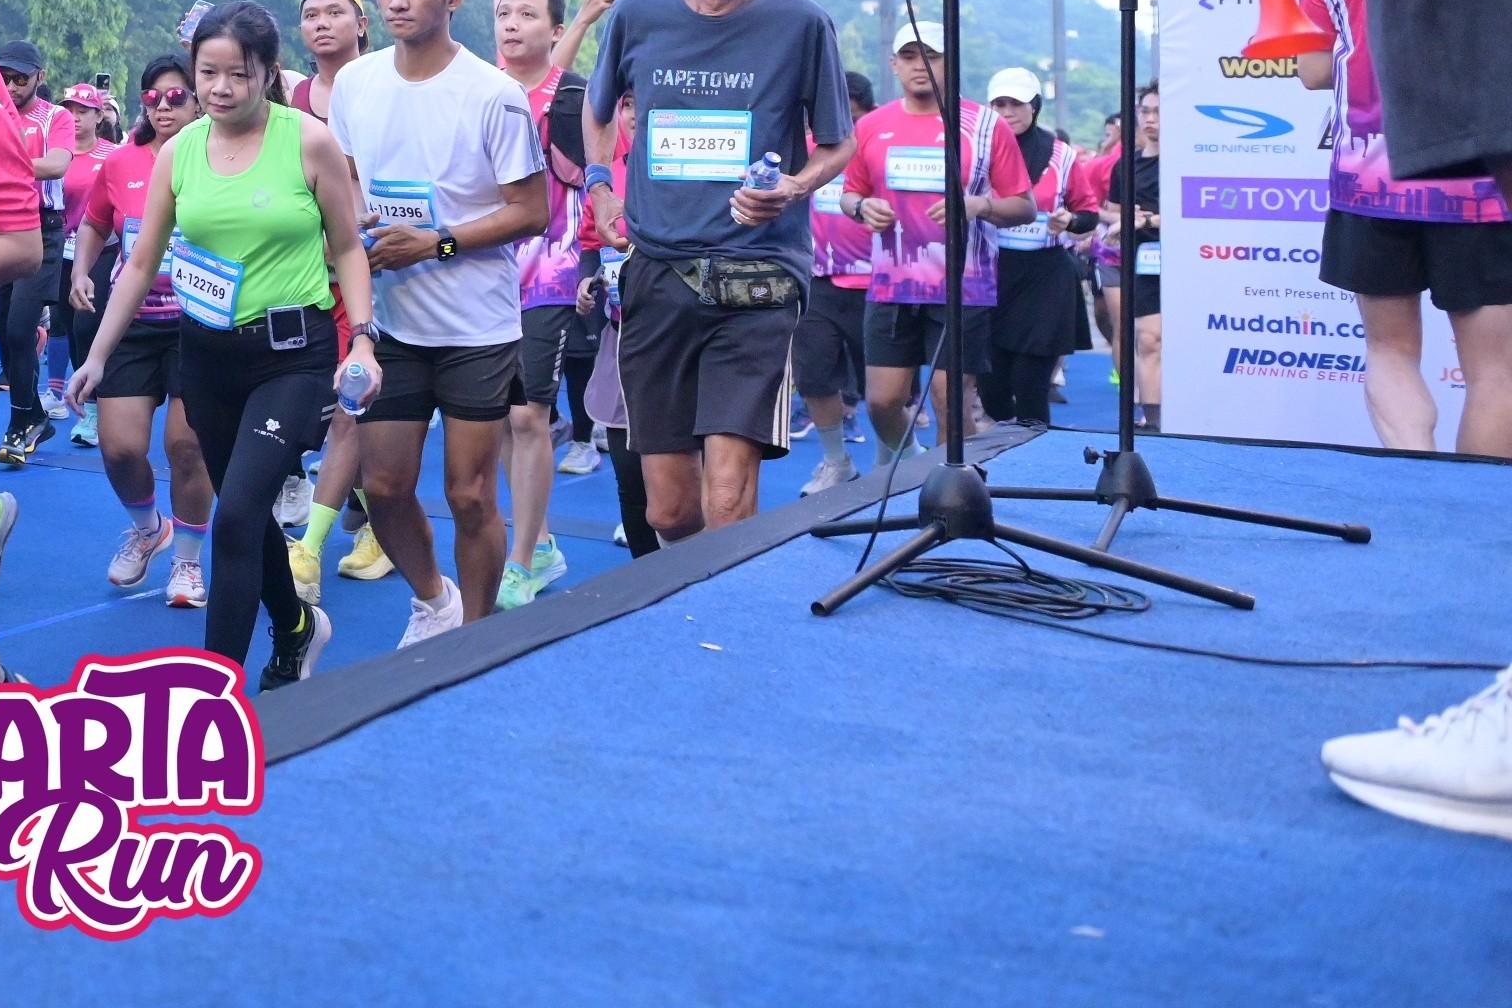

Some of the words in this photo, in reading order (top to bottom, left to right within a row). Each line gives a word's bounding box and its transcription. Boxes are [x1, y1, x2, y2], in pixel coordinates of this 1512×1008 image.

[652, 69, 755, 89] CAPETOWN
[660, 137, 736, 151] A-132879
[1194, 144, 1219, 153] 910
[1221, 144, 1296, 154] NINETEN
[175, 268, 226, 300] A-122769
[1244, 286, 1281, 298] Event
[1285, 288, 1336, 300] Present
[1340, 290, 1356, 303] by
[1234, 365, 1309, 379] RUNNING
